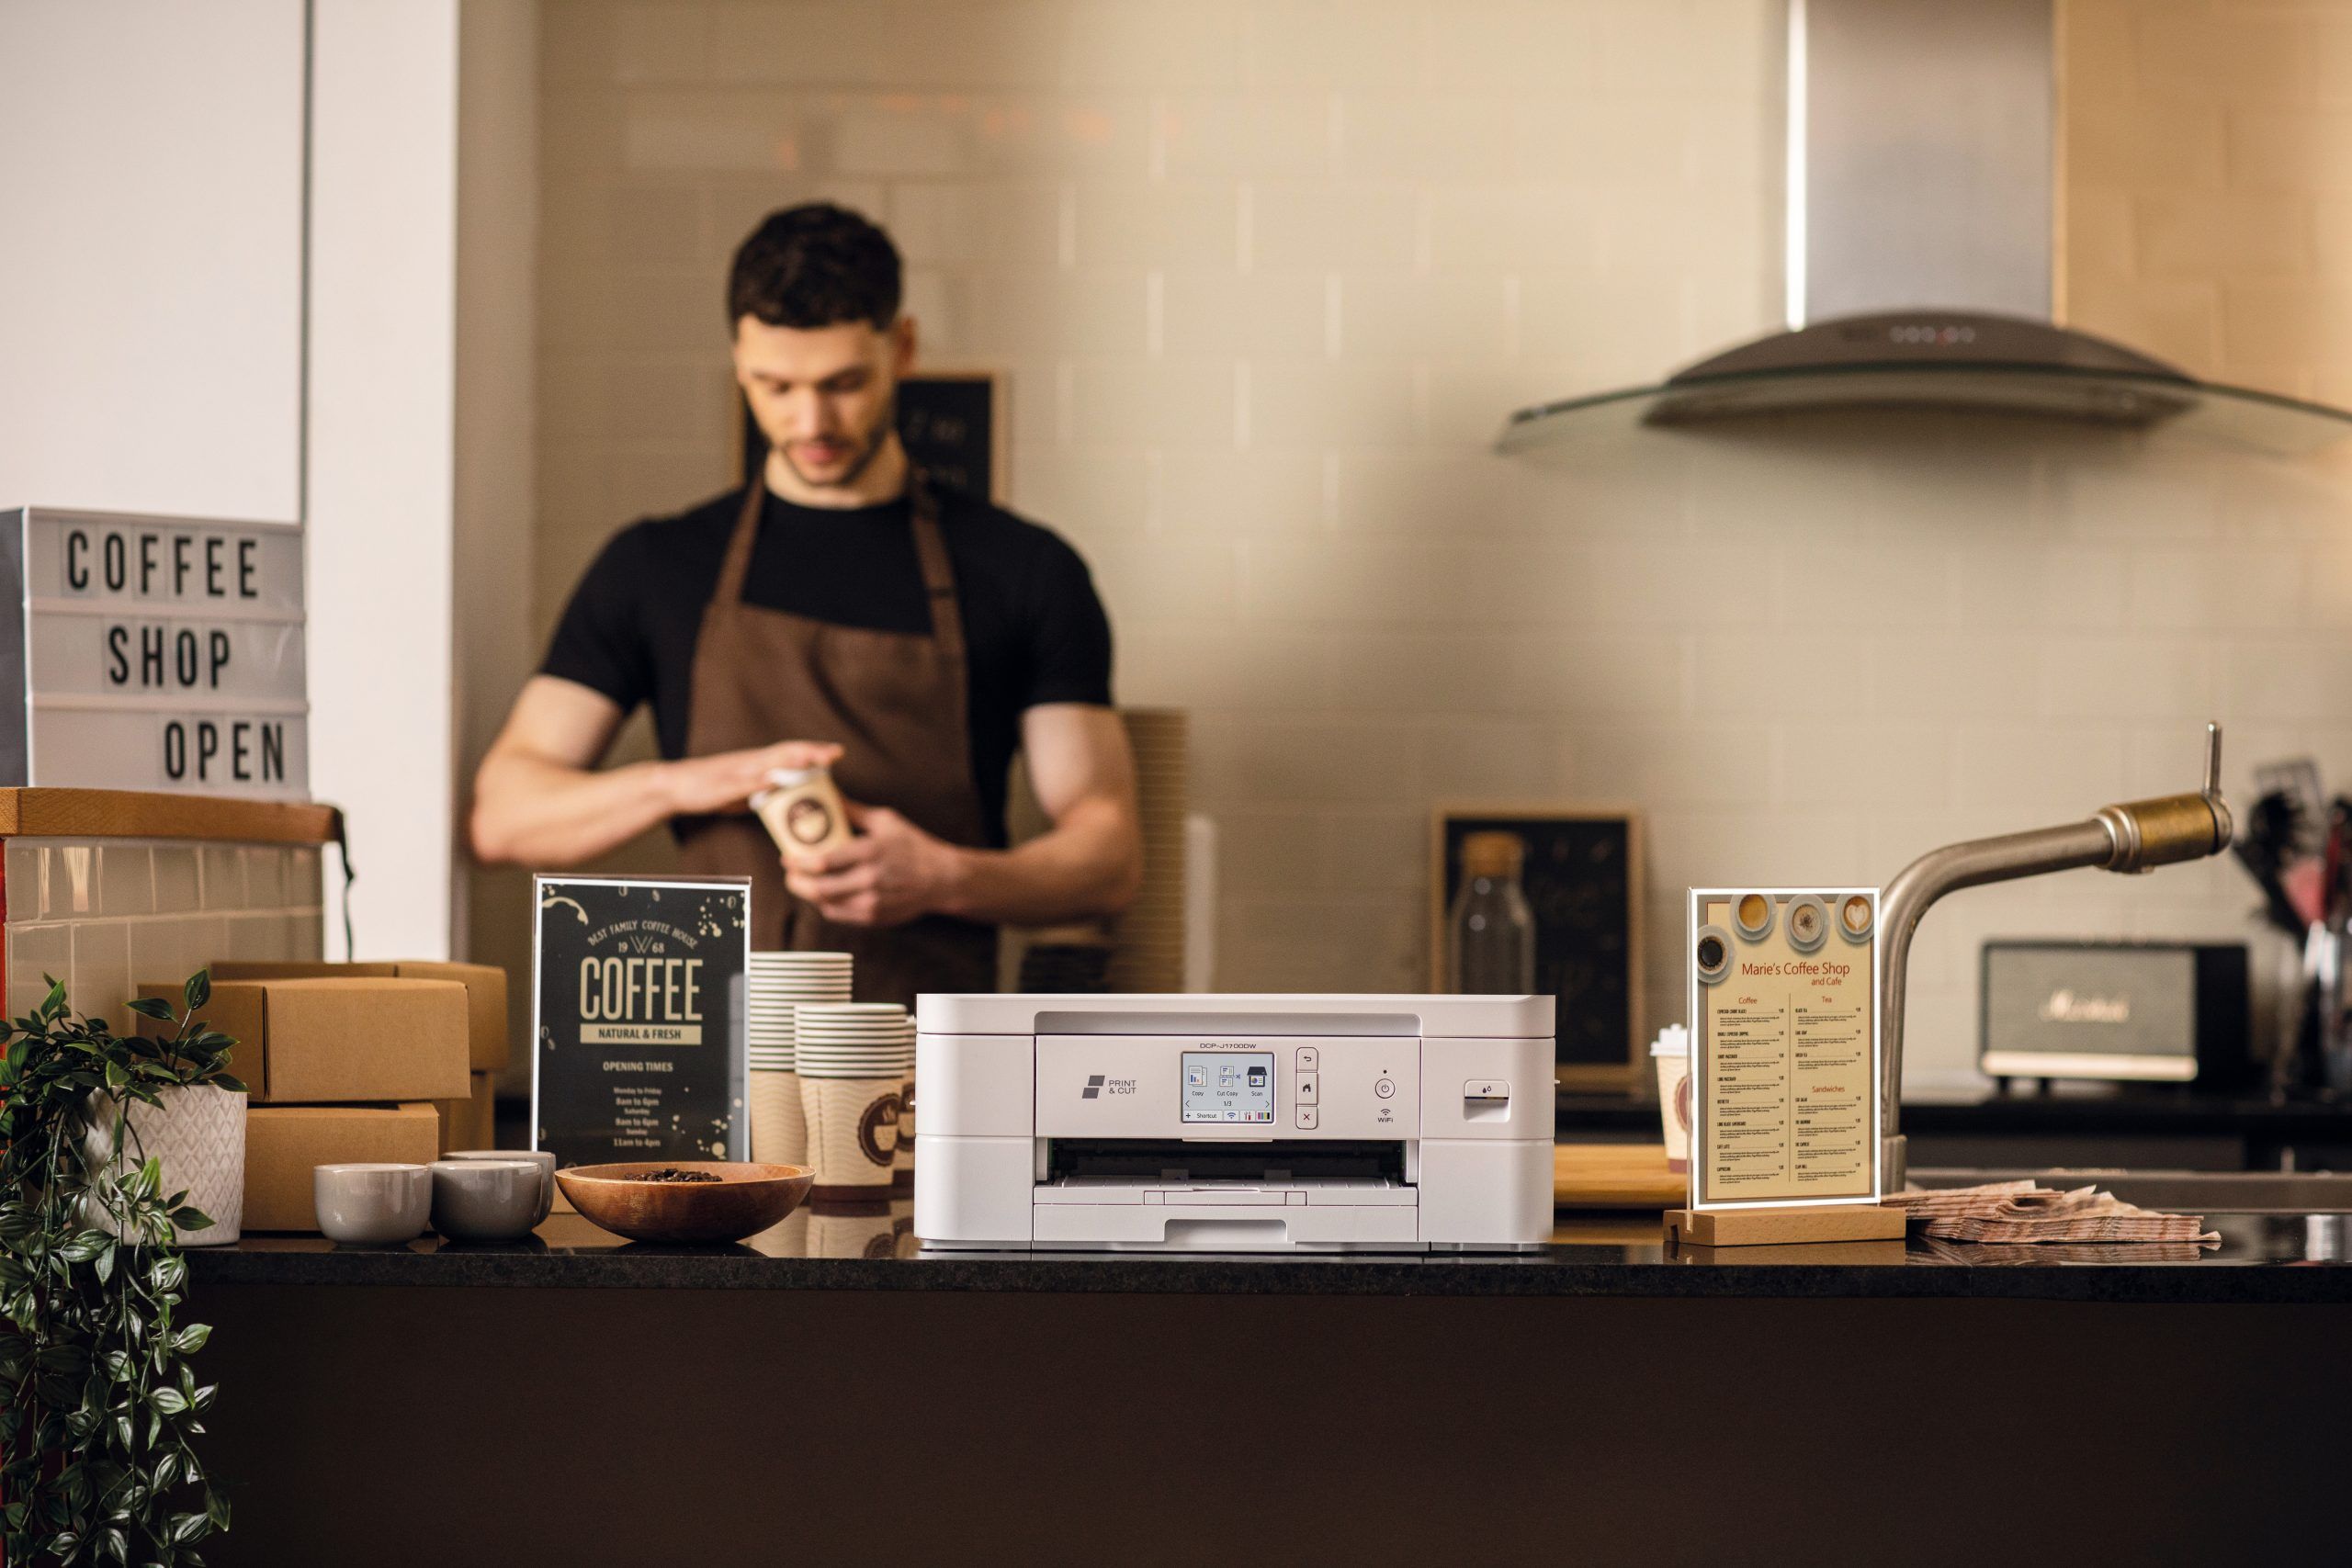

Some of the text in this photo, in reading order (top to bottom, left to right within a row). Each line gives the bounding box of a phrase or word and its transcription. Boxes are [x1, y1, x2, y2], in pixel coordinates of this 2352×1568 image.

[67, 529, 258, 598] COFFEE
[107, 625, 231, 689] SHOP
[164, 719, 285, 782] OPEN
[587, 919, 697, 949] BEST FAMILY COFFEE HOUSE
[618, 942, 665, 953] 19 68
[1742, 962, 1850, 977] Marie's Coffee Shop
[1811, 976, 1842, 987] and Cafe
[581, 956, 703, 1021] COFFEE
[1738, 997, 1758, 1005] Coffee
[1822, 996, 1833, 1004] Tea
[598, 1028, 682, 1040] NATURAL & FRESH
[603, 1060, 674, 1072] OPENING TIMES
[1117, 1087, 1137, 1095] CUT
[1227, 1089, 1238, 1098] Copy
[633, 1098, 641, 1106] to
[1223, 1100, 1232, 1108] 1/3
[1196, 1111, 1217, 1120] Shortcut
[633, 1118, 641, 1126] to
[635, 1138, 642, 1147] to
